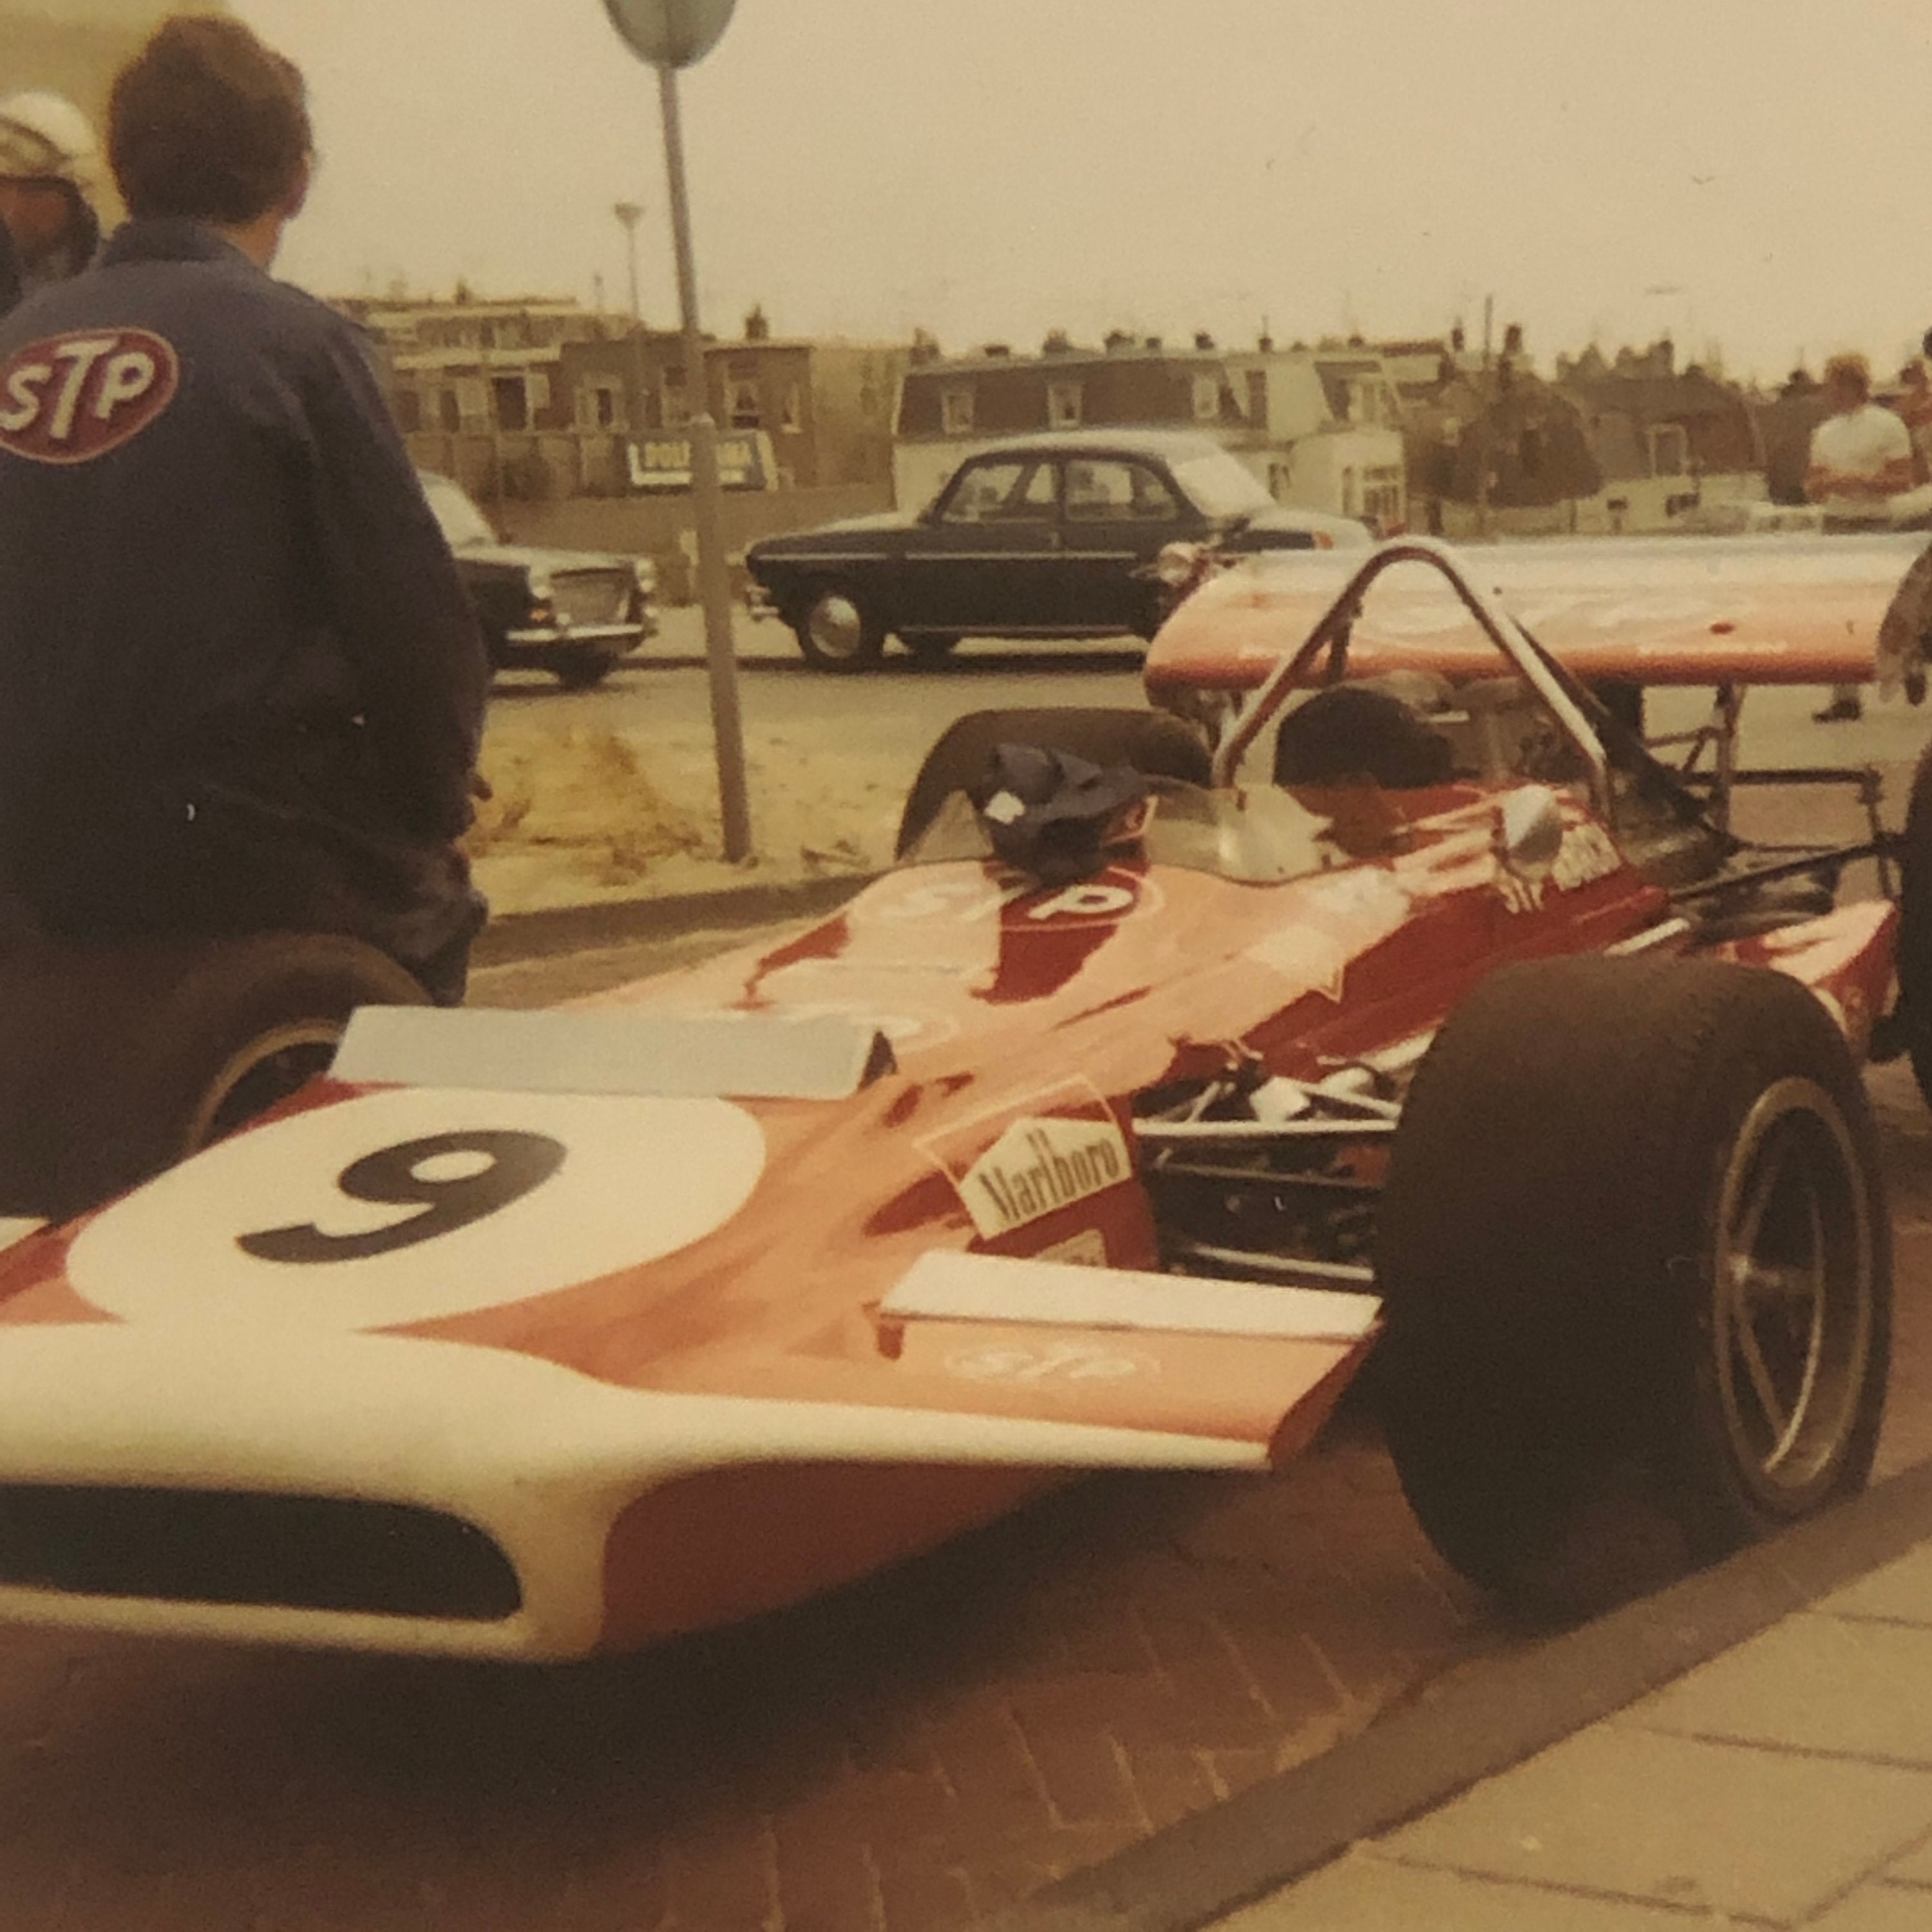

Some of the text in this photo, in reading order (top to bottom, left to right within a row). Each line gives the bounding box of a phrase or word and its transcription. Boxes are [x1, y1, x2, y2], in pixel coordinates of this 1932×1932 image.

[0, 338, 155, 439] STP
[234, 1130, 567, 1264] 9
[978, 1128, 1121, 1221] Marlboro
